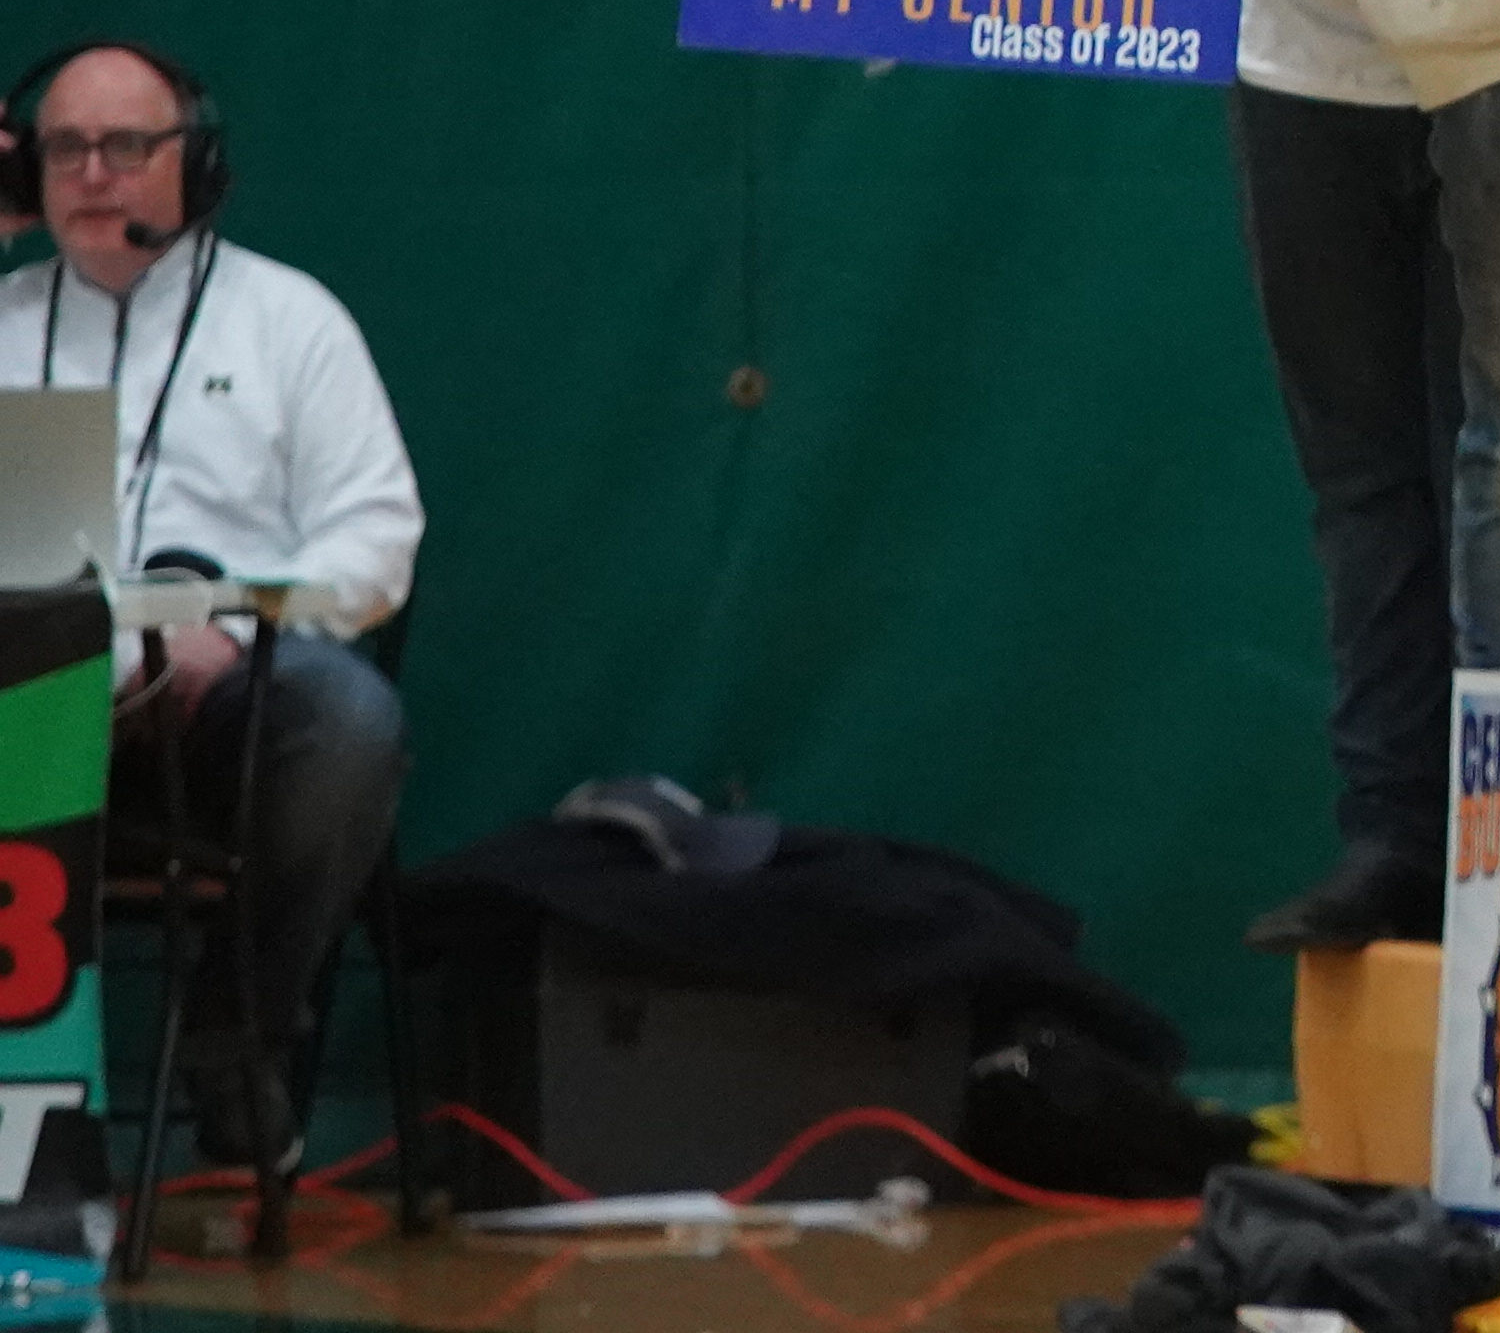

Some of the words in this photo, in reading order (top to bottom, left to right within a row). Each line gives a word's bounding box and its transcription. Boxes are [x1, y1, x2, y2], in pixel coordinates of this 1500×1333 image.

[970, 16, 1063, 63] Class
[1071, 22, 1109, 66] of
[1116, 25, 1201, 71] 2023
